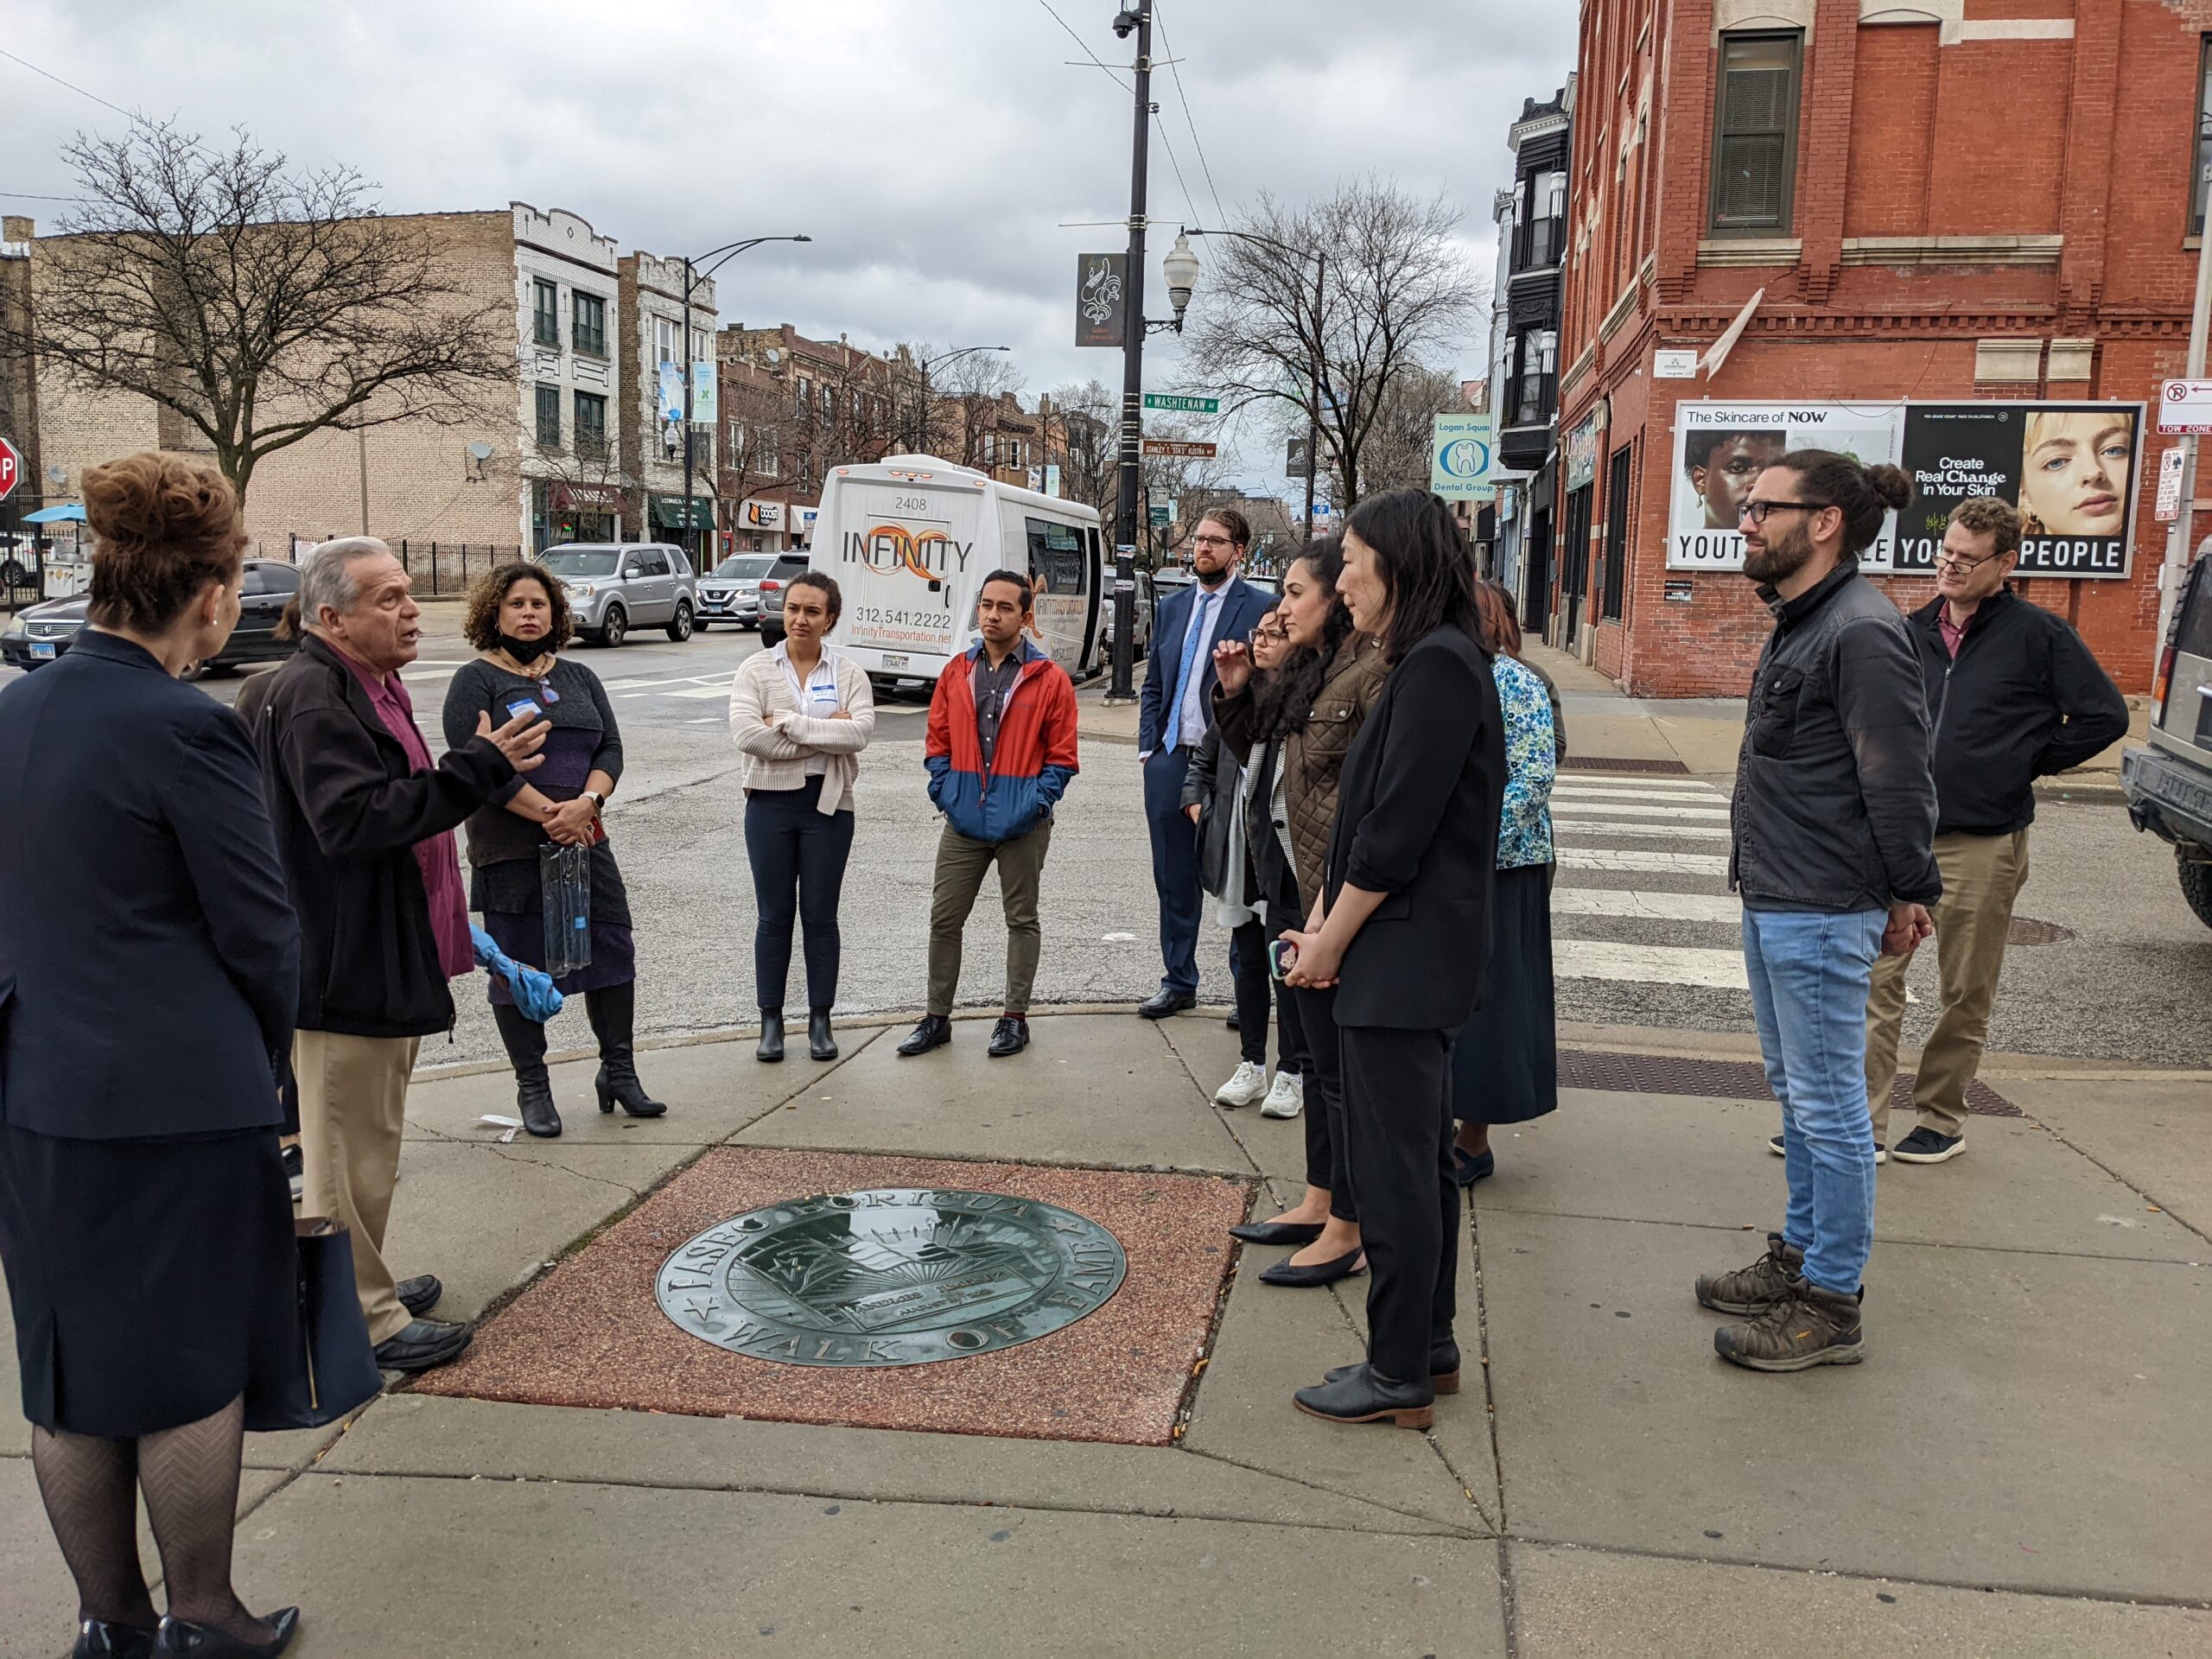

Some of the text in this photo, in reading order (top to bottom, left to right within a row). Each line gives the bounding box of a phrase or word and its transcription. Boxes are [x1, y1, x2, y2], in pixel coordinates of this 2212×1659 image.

[1154, 396, 1206, 411] WASHTENAW
[1687, 410, 1827, 423] The Skincare of NOW
[1440, 423, 1464, 432] Logan
[1146, 445, 1165, 454] STANLEY
[1939, 457, 1985, 469] Create
[1915, 470, 2006, 486] Real Change
[1465, 483, 1493, 493] Group
[1923, 484, 1996, 496] in Your Skin
[895, 497, 926, 511] 2408
[760, 506, 779, 519] boost
[842, 531, 974, 573] INFINITY
[1679, 536, 1745, 559] YOUT
[2019, 540, 2120, 567] PEOPLE
[856, 607, 950, 629] 312.541.2222
[851, 624, 951, 644] InfinityTransportation.net
[668, 1218, 770, 1293] PASEO
[727, 1241, 1116, 1362] WALK OF FAME
